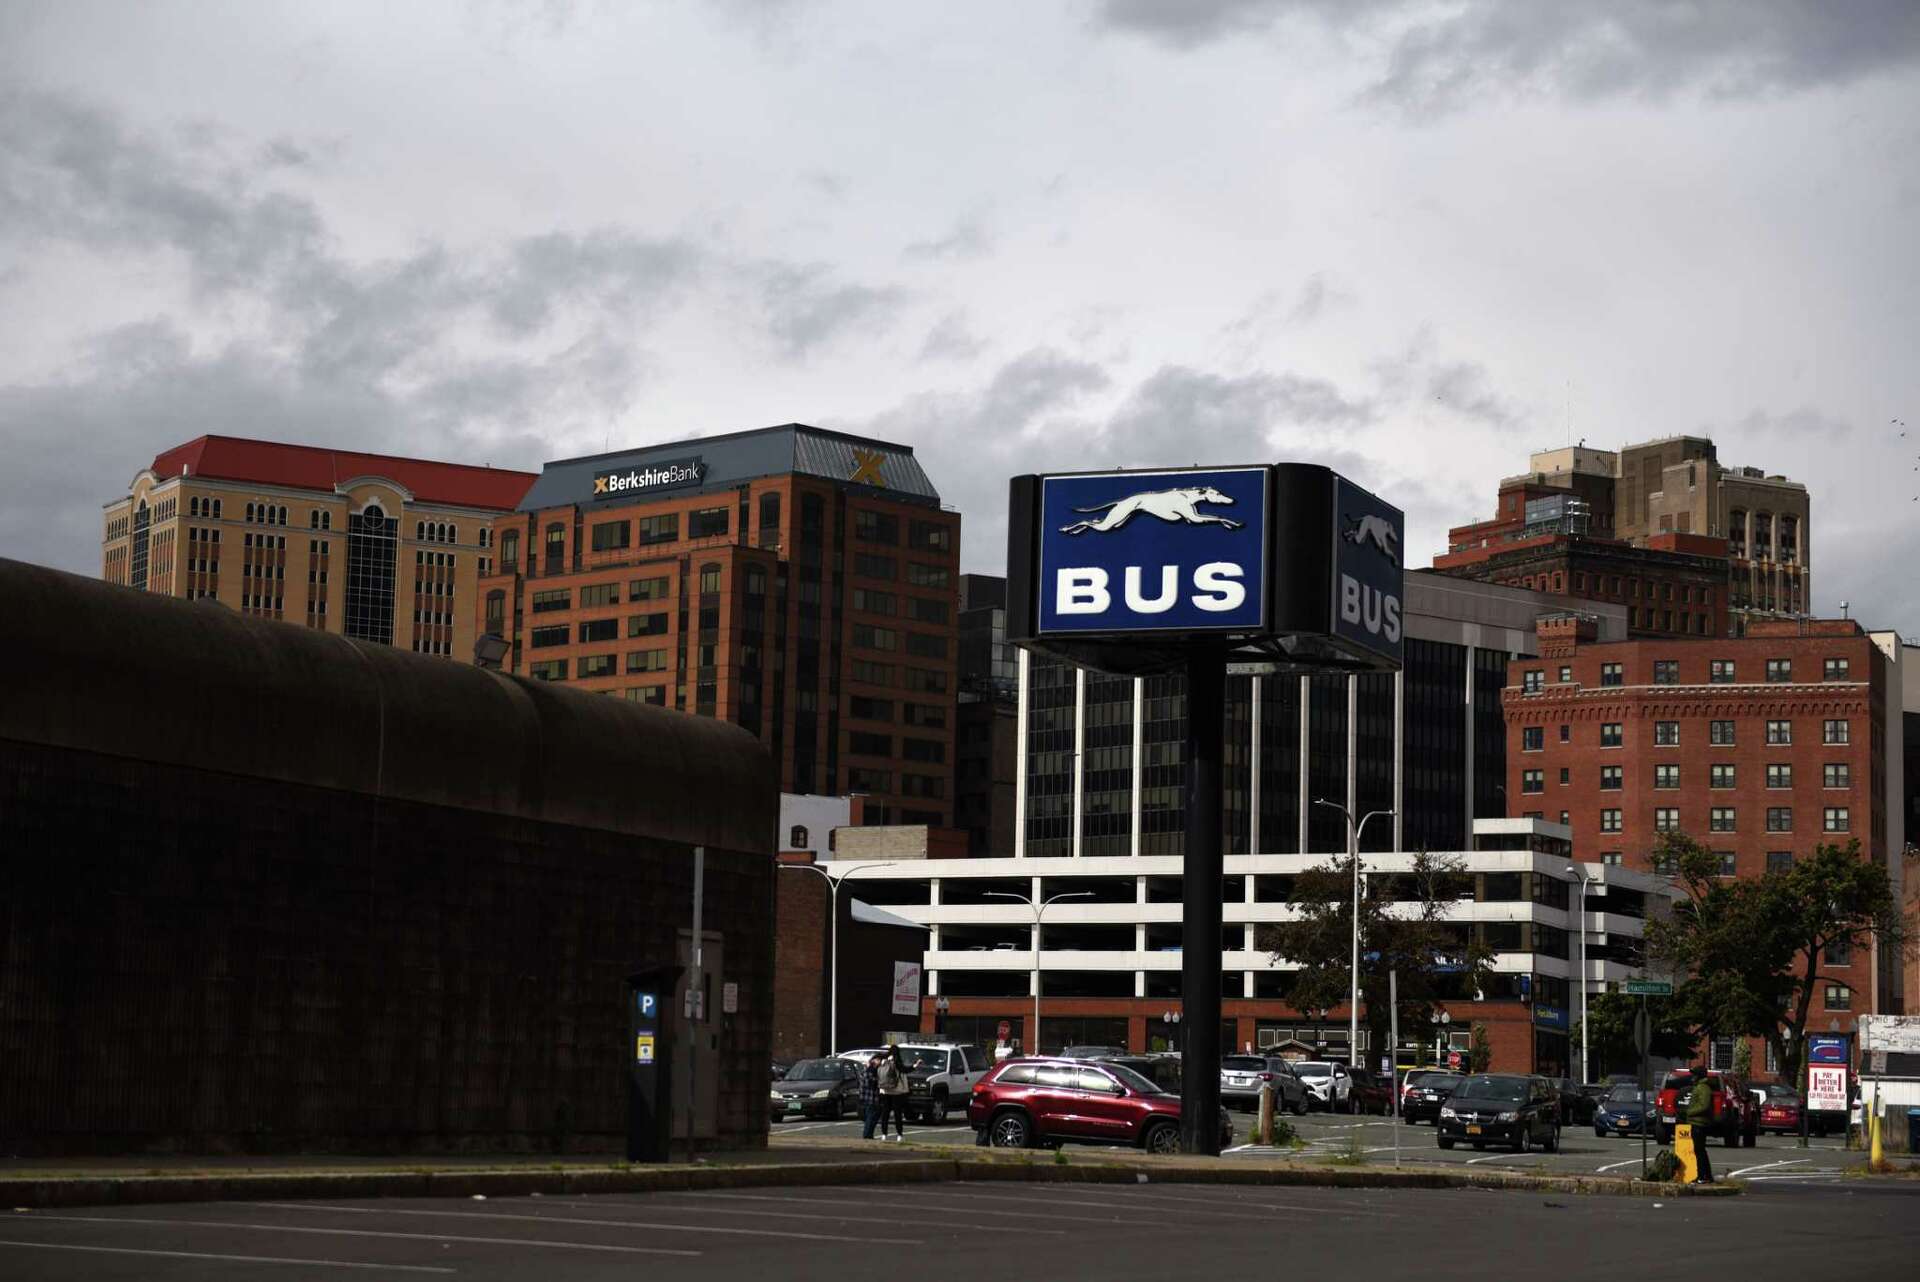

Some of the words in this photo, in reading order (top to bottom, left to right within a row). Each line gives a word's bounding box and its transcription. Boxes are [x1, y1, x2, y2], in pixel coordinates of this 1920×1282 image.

[609, 463, 699, 491] BerkshireBank
[1055, 561, 1246, 615] BUS
[1341, 573, 1401, 644] BUS
[642, 995, 654, 1014] P
